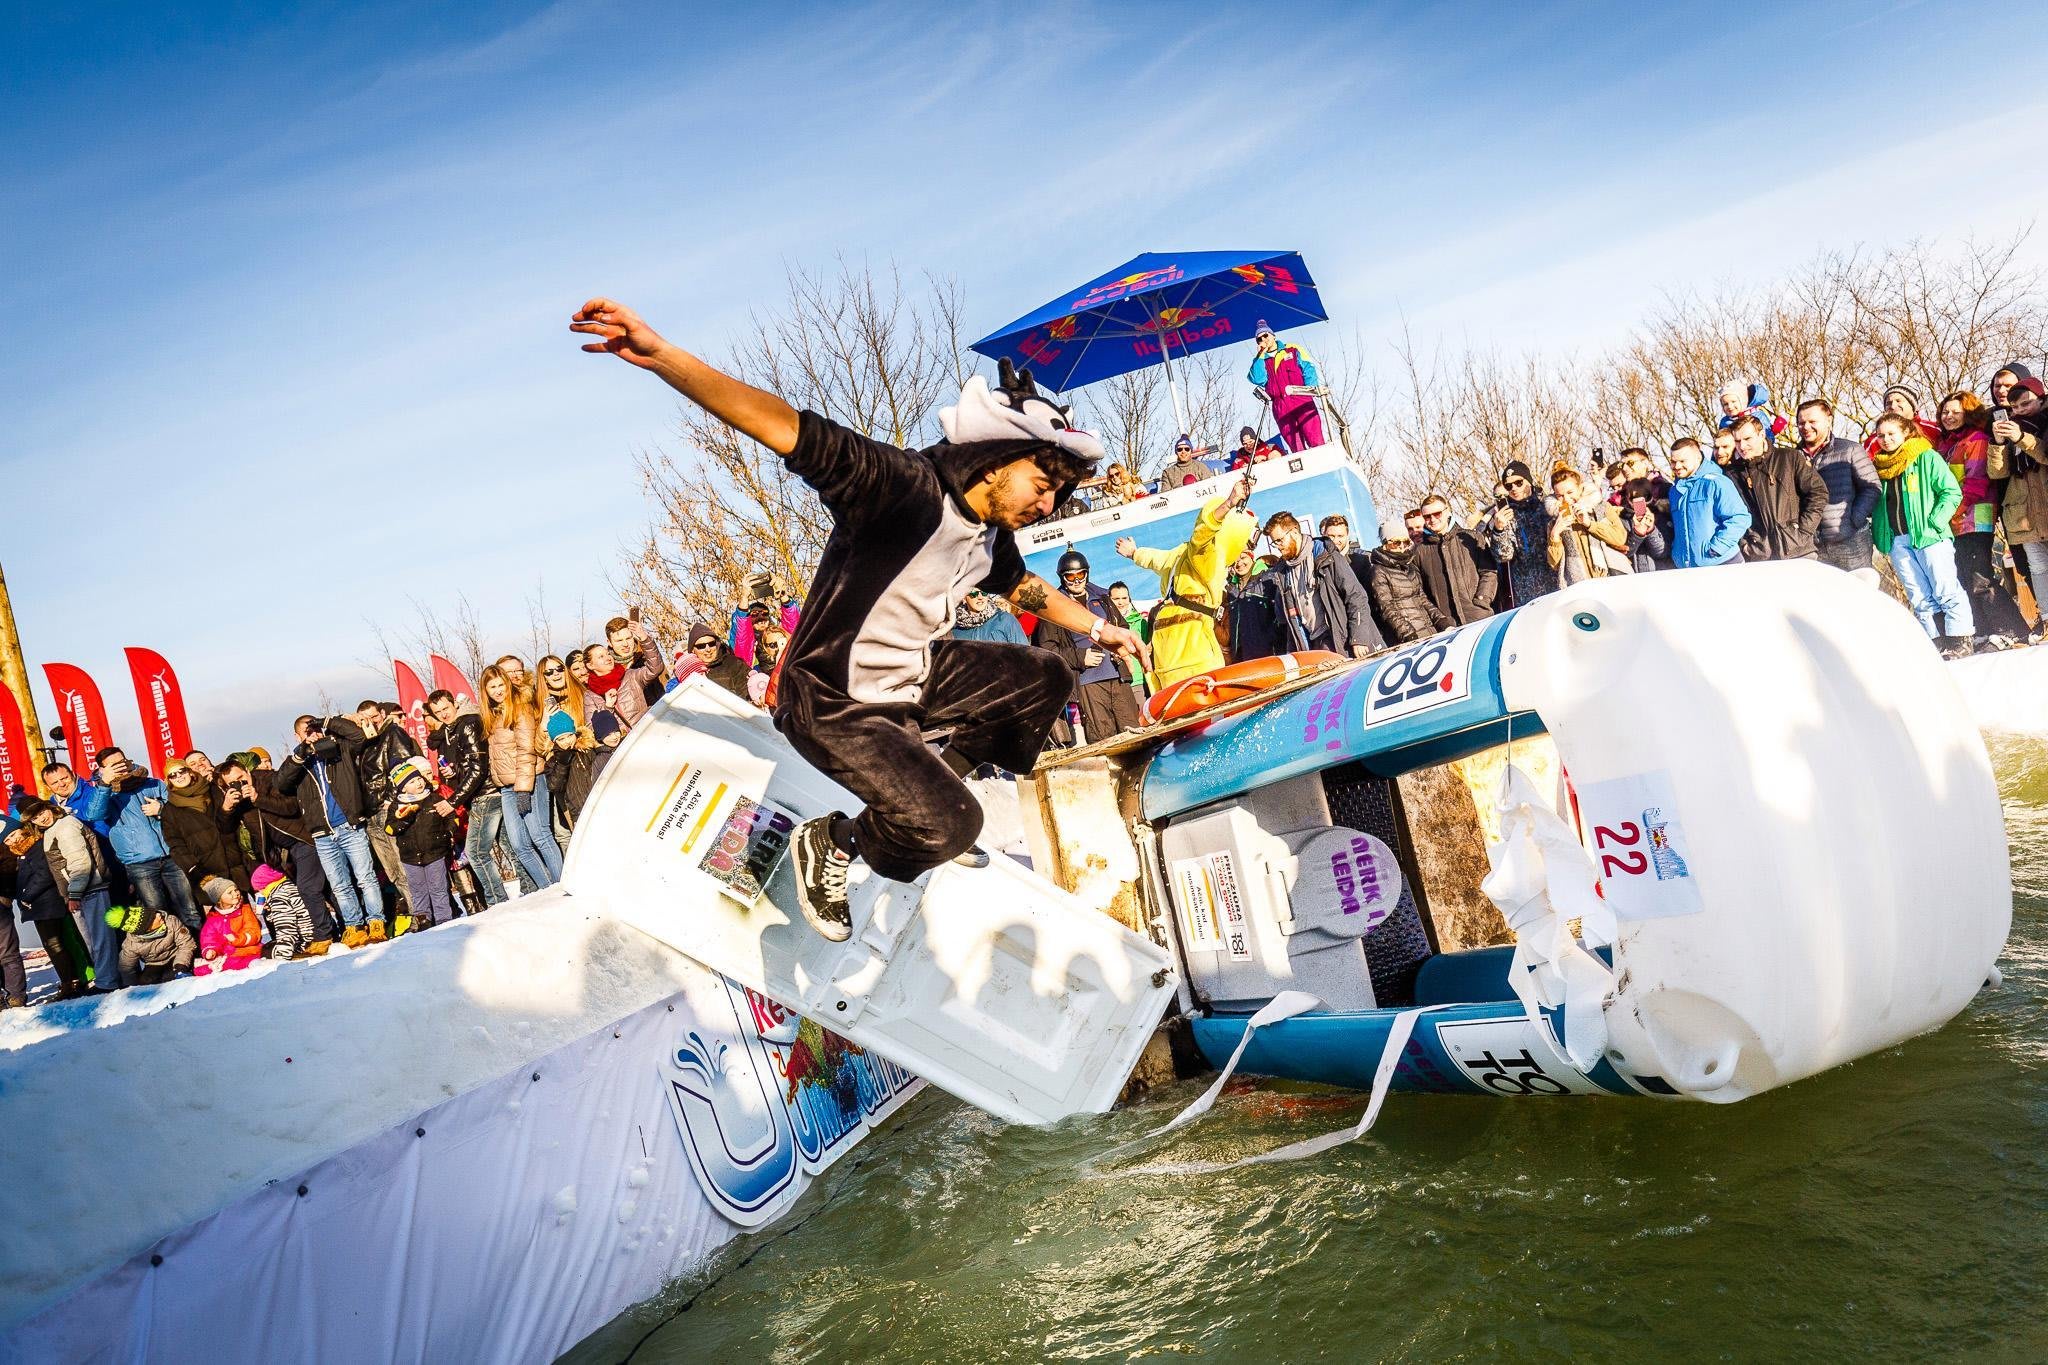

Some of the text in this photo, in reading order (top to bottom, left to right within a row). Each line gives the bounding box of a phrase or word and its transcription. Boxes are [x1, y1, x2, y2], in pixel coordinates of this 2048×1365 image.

[1072, 270, 1185, 310] Red Bull
[1195, 485, 1218, 498] SALT
[1032, 527, 1063, 540] GoPro
[656, 769, 702, 840] nusinešate indus!
[676, 814, 690, 829] kad
[1594, 821, 1648, 878] 22
[1463, 1050, 1534, 1095] TO
[1500, 1049, 1571, 1094] TO
